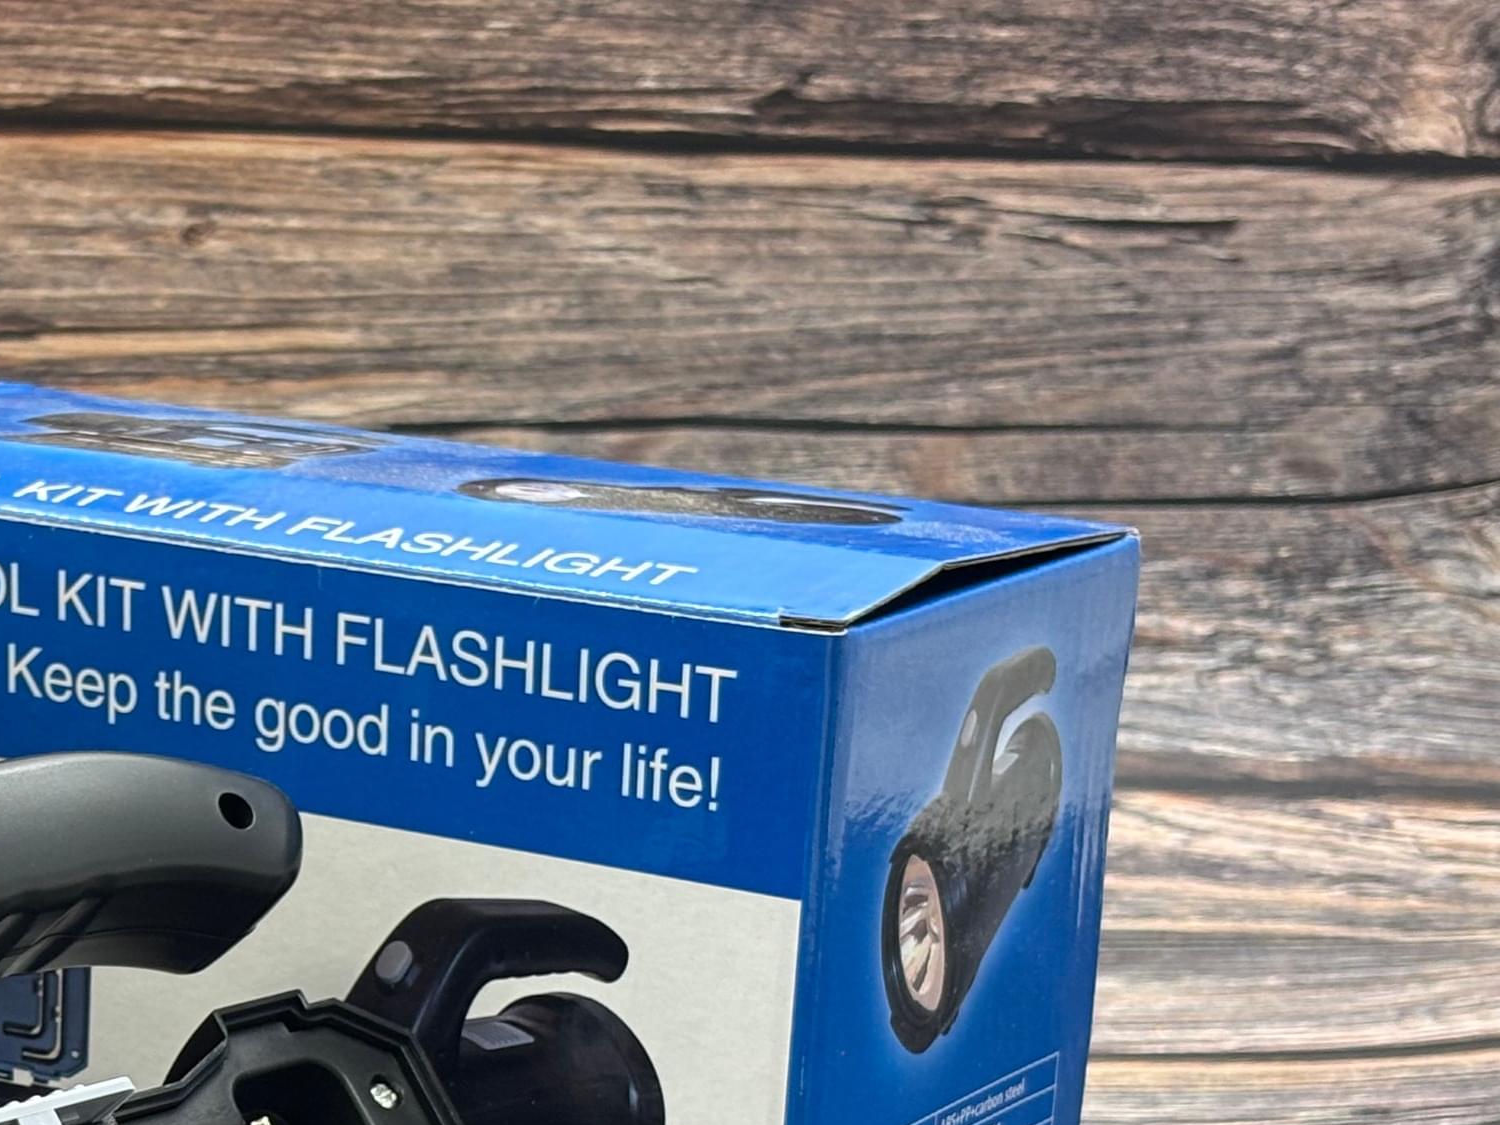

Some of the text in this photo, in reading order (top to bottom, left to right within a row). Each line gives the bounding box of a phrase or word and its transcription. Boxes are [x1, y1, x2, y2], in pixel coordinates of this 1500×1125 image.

[13, 479, 124, 508] KIT
[123, 493, 288, 532] WITH
[284, 514, 700, 586] FLASHLIGHT
[56, 568, 147, 633] KIT
[162, 585, 314, 661] WITH
[336, 611, 738, 723] FLASHLIGHT
[6, 642, 721, 812] Keep the good in your life!
[1003, 1077, 1027, 1107] steel
